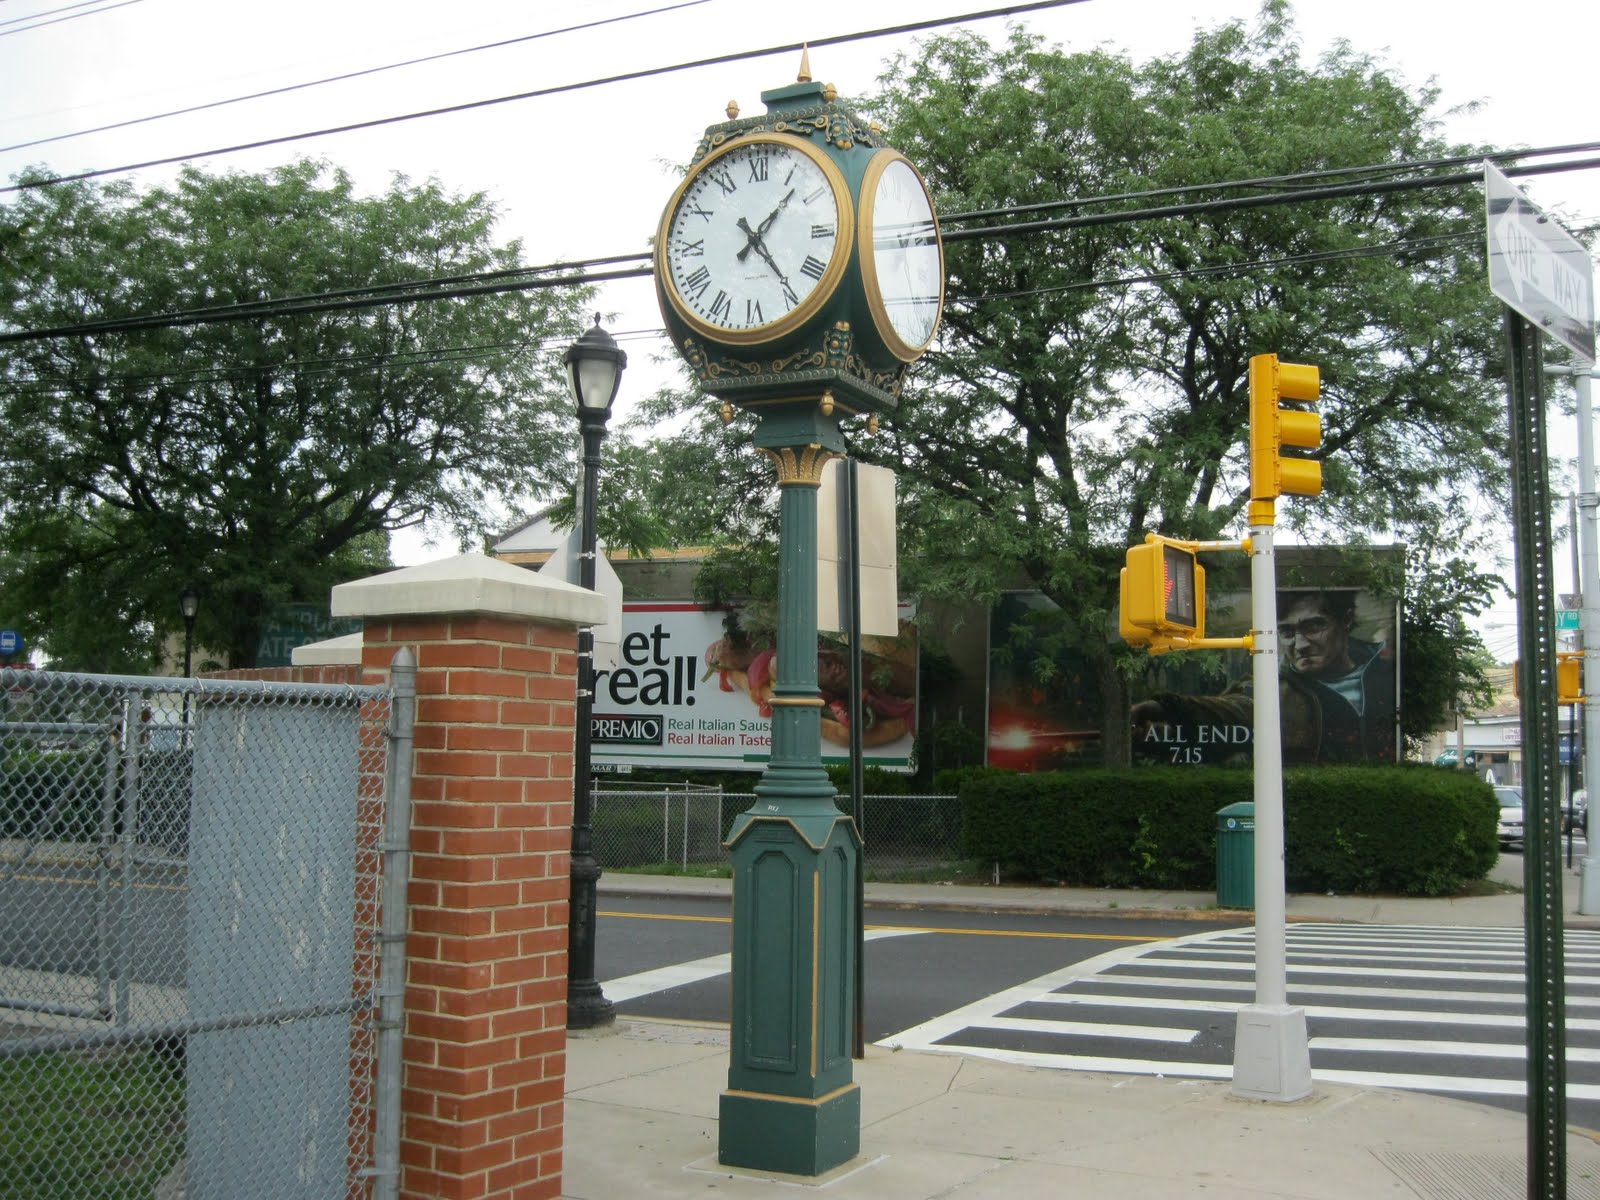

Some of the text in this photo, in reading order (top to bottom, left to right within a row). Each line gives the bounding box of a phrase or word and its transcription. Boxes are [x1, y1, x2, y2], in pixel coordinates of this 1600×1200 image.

[748, 156, 769, 183] XII
[1507, 222, 1581, 319] ONE WAY
[1567, 611, 1578, 621] RD
[622, 623, 671, 667] et
[593, 656, 697, 706] real!
[590, 719, 659, 739] PREMIO
[668, 719, 694, 730] Real
[698, 719, 735, 731] Italian
[1144, 724, 1254, 744] ALL END
[667, 733, 772, 747] Real Italian Taste
[1169, 746, 1202, 764] 7.15
